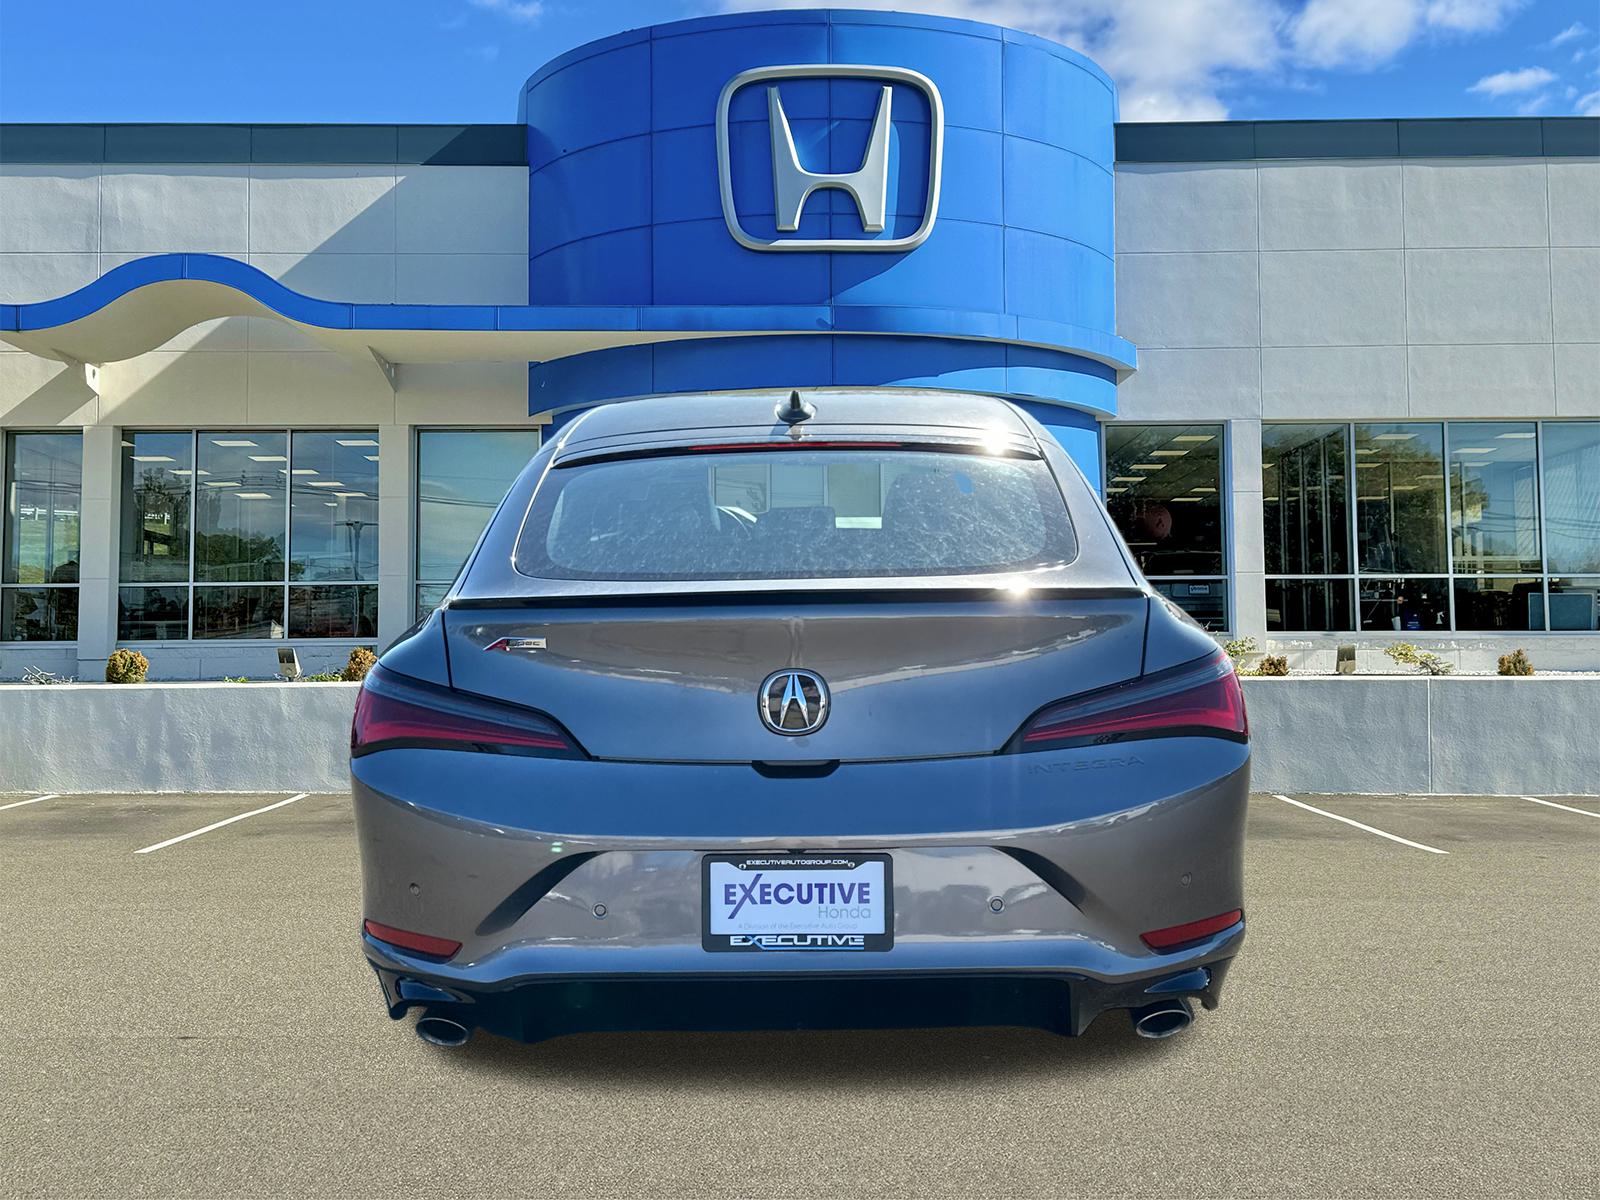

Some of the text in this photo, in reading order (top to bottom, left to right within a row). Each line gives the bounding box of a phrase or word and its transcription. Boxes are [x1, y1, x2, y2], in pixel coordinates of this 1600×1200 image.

[1026, 756, 1145, 774] INTEGRA
[724, 873, 870, 919] EXECUTIVE
[818, 906, 871, 919] Honda
[729, 935, 865, 946] EXECUTIVE
